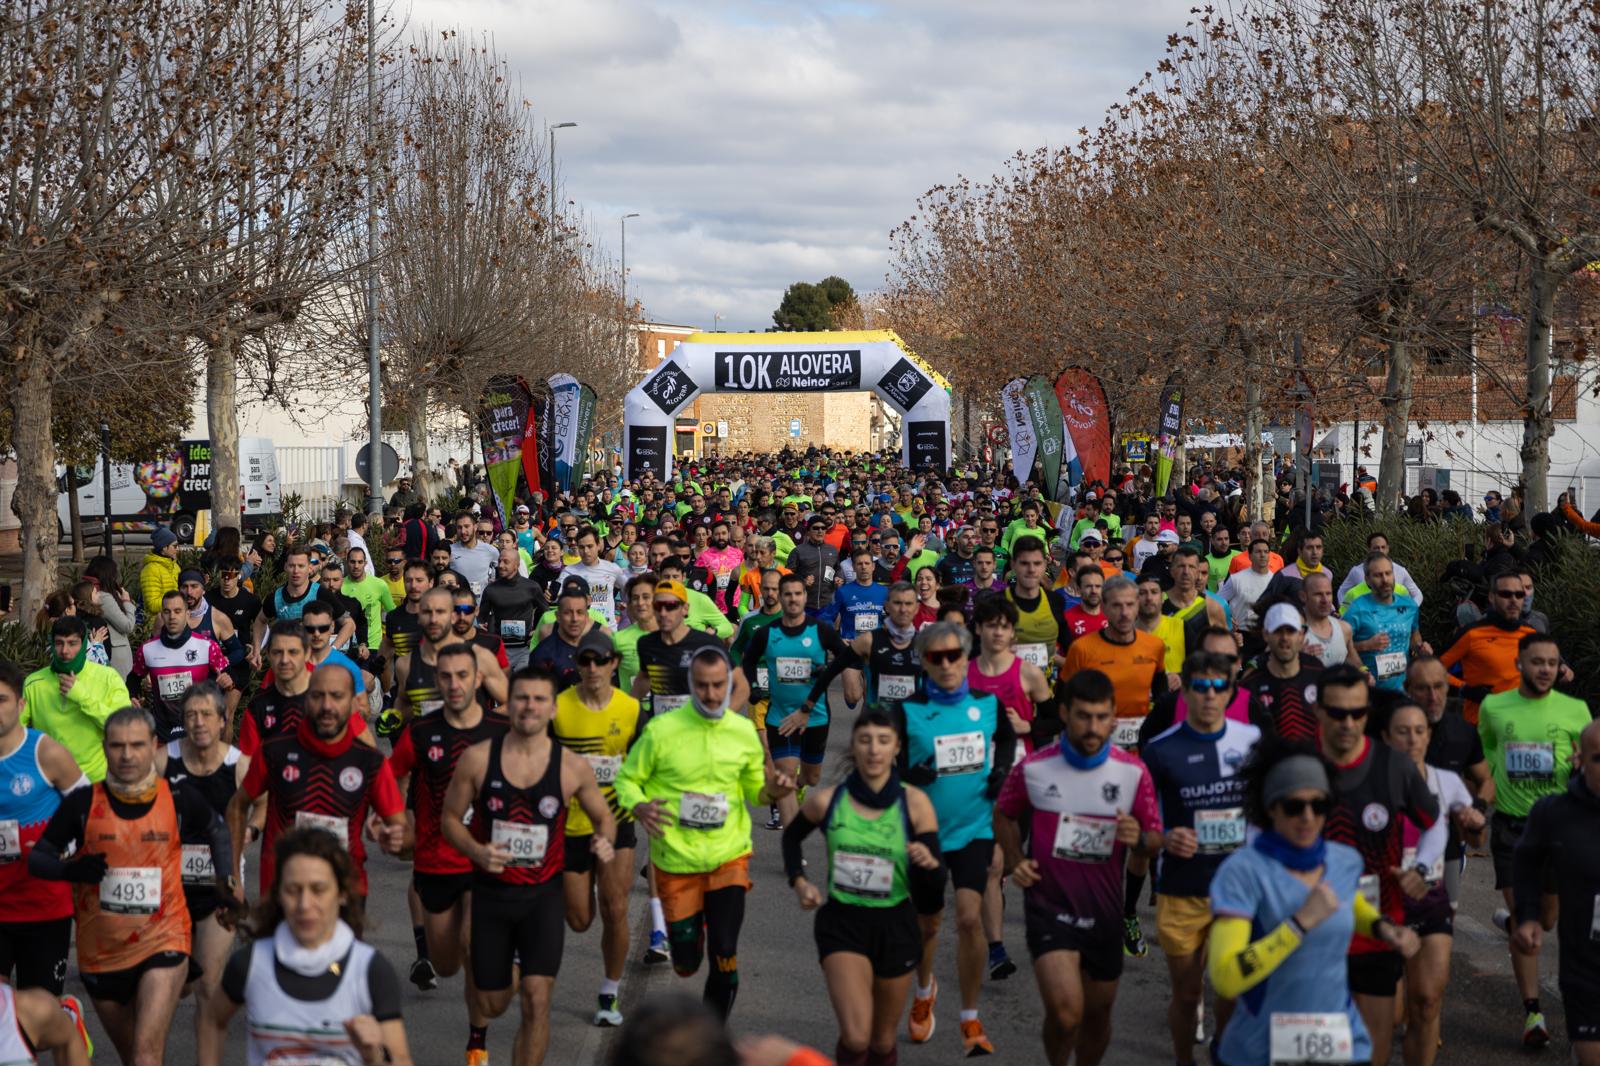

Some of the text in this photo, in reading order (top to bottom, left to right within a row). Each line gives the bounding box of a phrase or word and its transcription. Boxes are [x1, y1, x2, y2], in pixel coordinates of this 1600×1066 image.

[724, 354, 773, 390] 10K
[780, 353, 853, 375] ALOVERA
[792, 376, 831, 388] Neinor
[666, 384, 688, 406] ALOVERA
[493, 406, 514, 418] para
[580, 402, 592, 438] Alovera
[492, 416, 520, 434] crecer!
[784, 666, 803, 676] 246
[1385, 661, 1400, 673] 204
[166, 680, 186, 693] 135
[888, 685, 908, 697] 329
[950, 746, 975, 764] 378
[1510, 753, 1542, 769] 1186
[692, 804, 720, 821] 262
[1202, 823, 1237, 840] 1163
[186, 857, 214, 873] 494
[851, 867, 874, 886] 37
[112, 882, 146, 902] 493
[1294, 1032, 1334, 1057] 168
